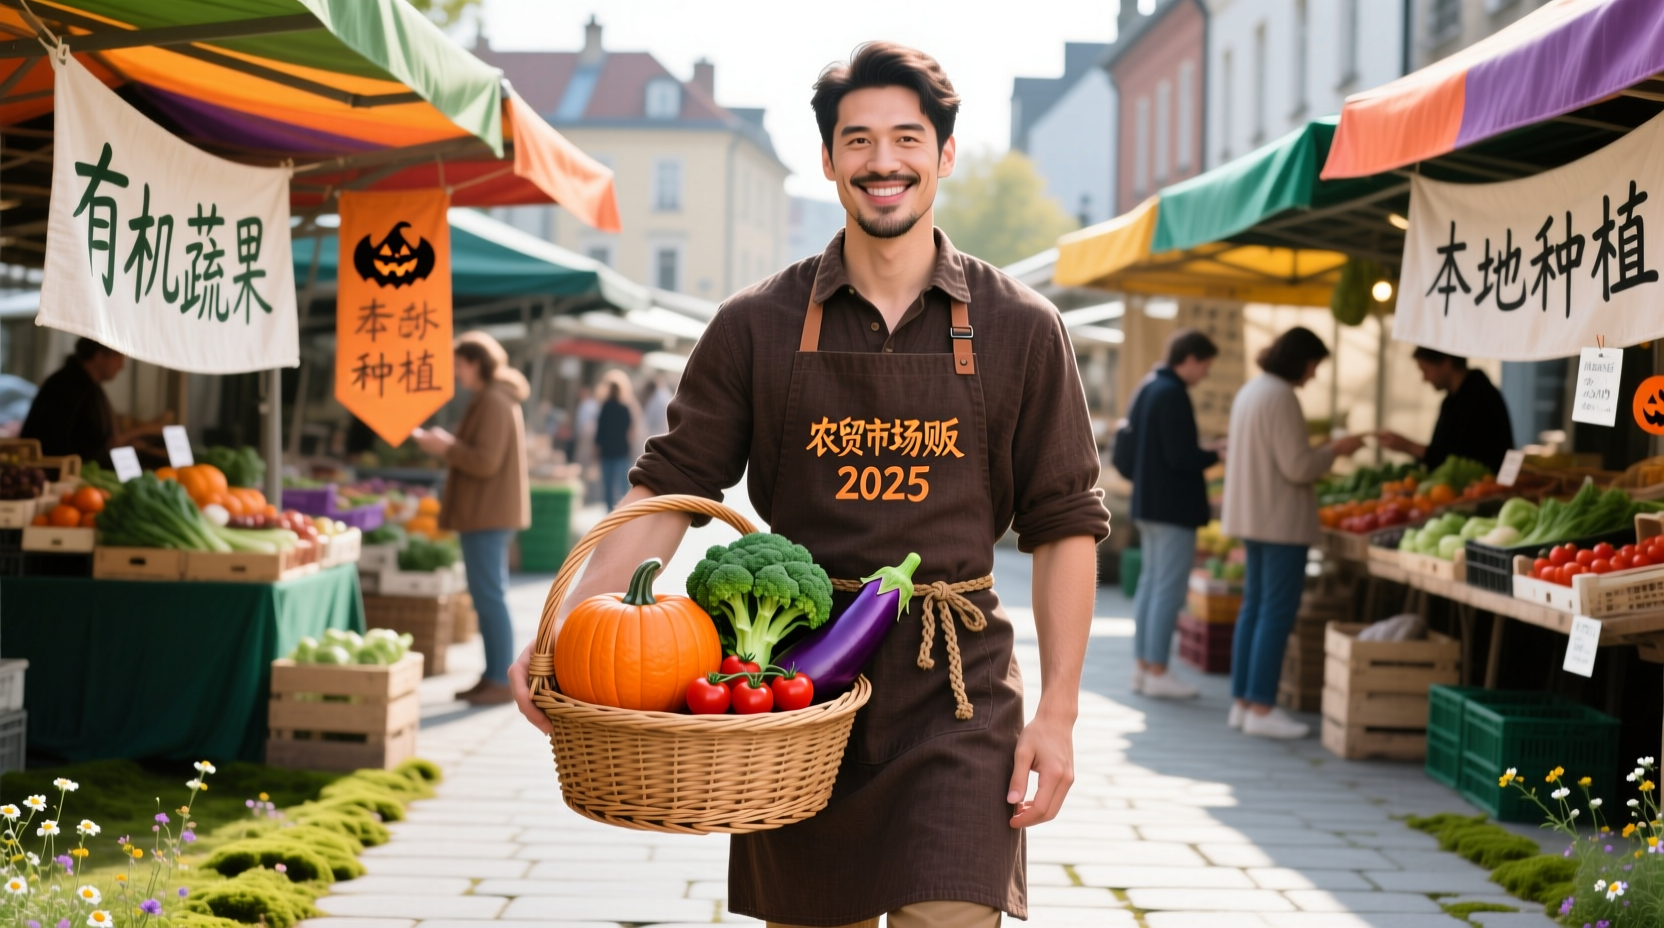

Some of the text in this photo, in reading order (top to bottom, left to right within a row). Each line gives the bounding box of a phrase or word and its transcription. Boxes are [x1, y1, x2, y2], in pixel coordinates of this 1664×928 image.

[73, 142, 273, 325] 有机蔬果
[1425, 180, 1659, 319] 本地种植
[351, 349, 442, 398] 种植
[806, 416, 965, 458] 农贸市场贩
[835, 466, 930, 502] 2025
